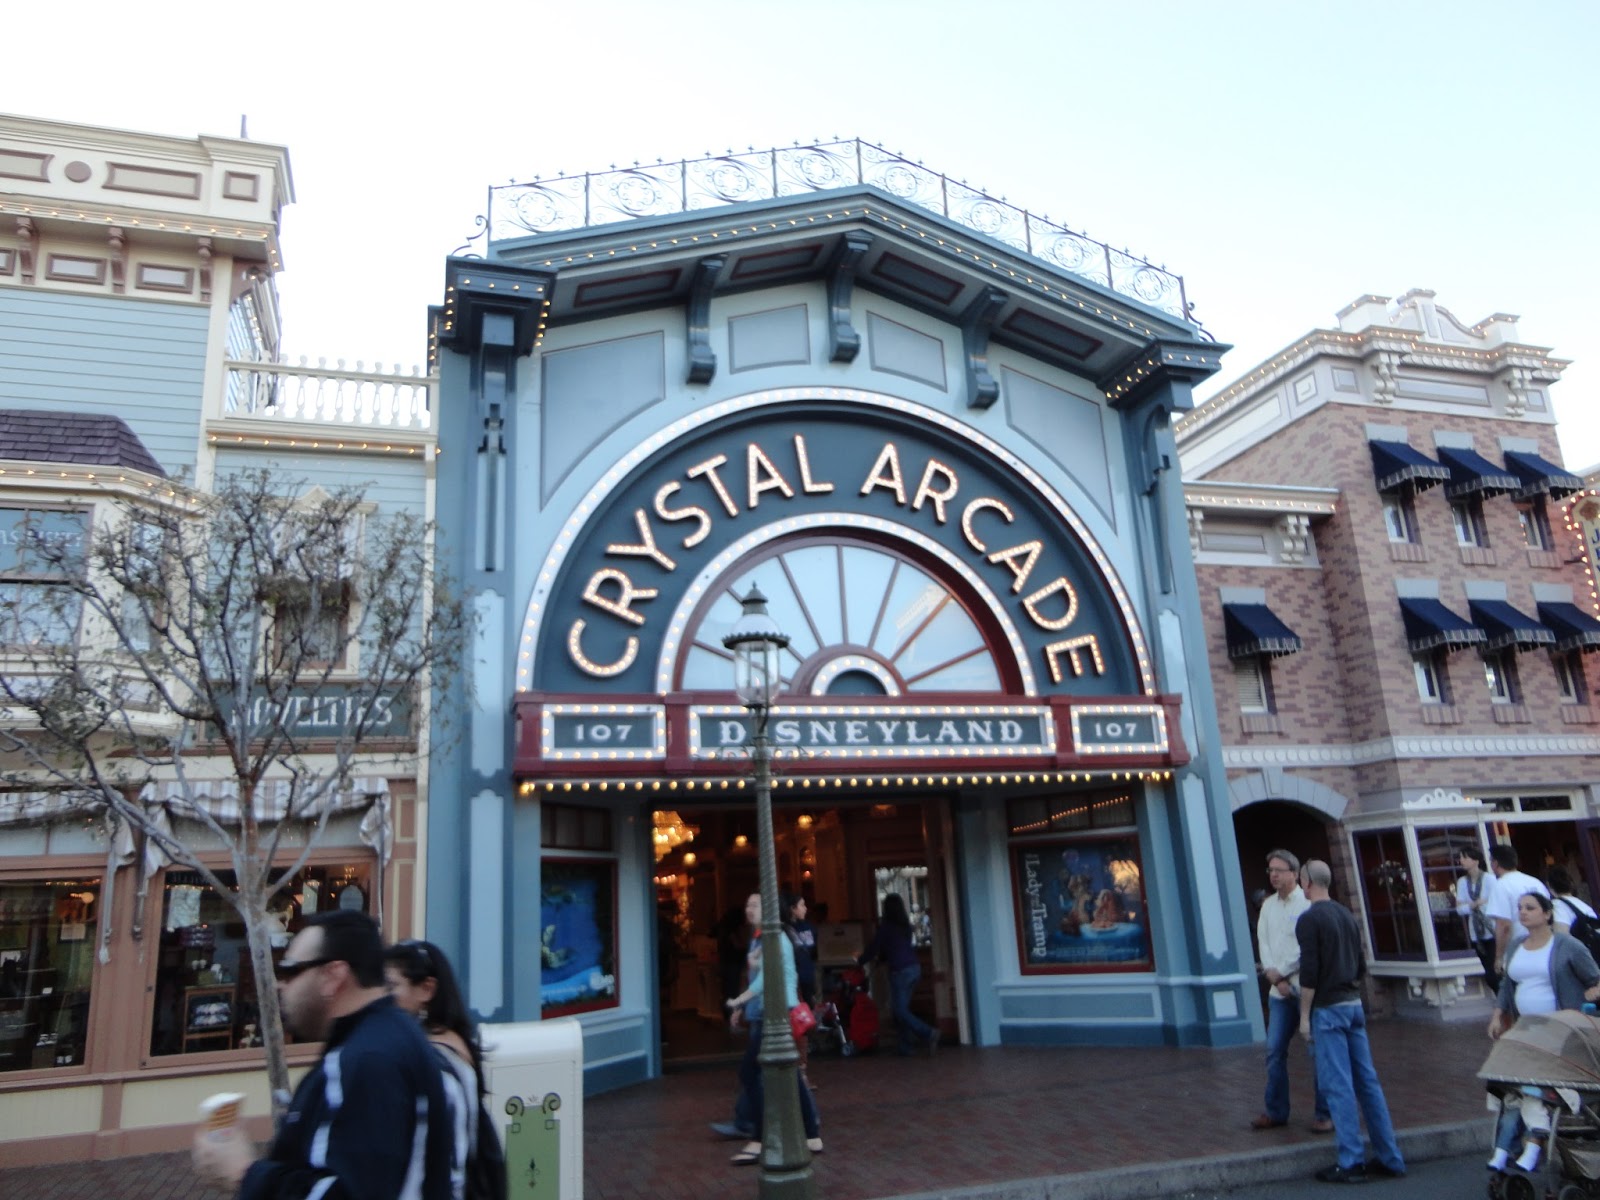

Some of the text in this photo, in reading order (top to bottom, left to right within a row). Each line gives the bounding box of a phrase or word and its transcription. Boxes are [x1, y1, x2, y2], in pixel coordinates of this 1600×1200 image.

[568, 435, 1106, 684] CRYSTAL ARCADE
[575, 724, 632, 741] 107
[720, 720, 1024, 745] DSNEYLAND
[1095, 722, 1138, 739] 107
[1031, 903, 1048, 957] Tramp
